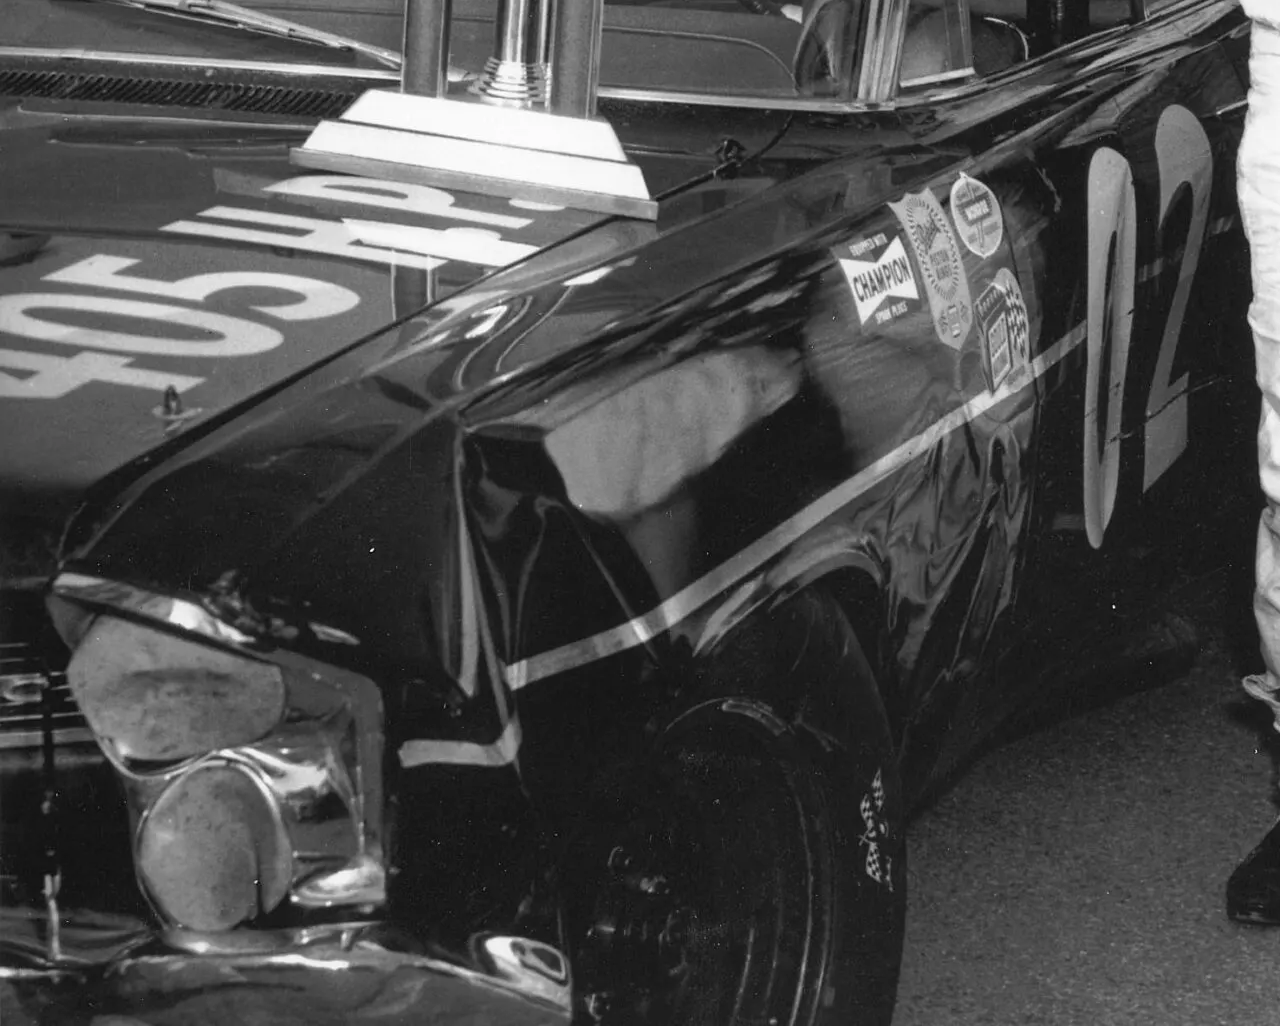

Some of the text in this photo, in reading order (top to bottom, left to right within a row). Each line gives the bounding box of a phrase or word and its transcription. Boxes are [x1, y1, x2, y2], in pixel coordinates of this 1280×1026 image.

[0, 254, 361, 399] 405
[853, 255, 912, 303] CHAMPION
[1083, 104, 1213, 550] 02
